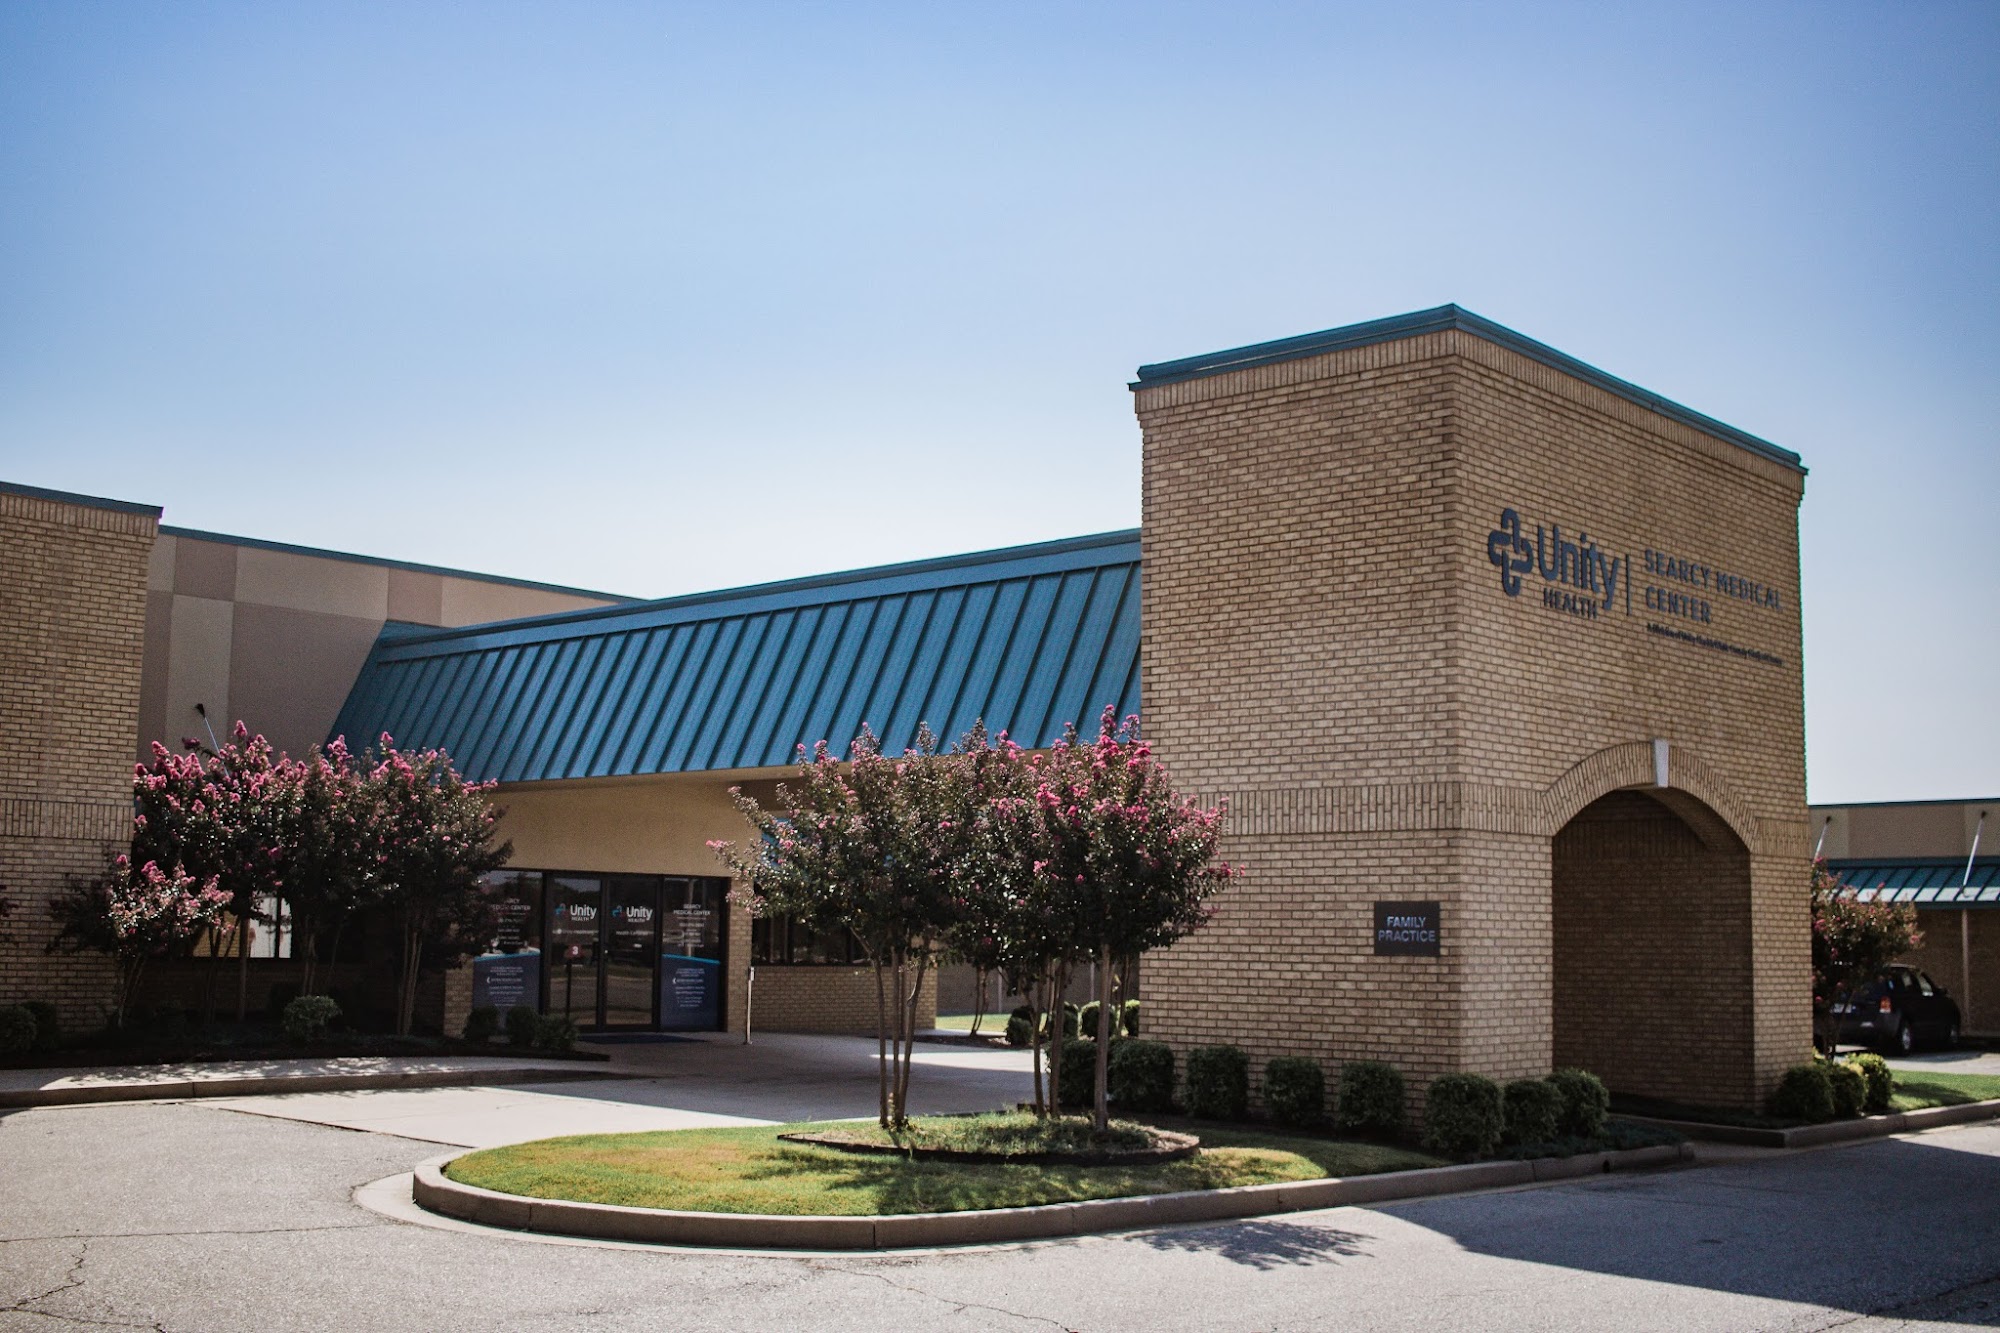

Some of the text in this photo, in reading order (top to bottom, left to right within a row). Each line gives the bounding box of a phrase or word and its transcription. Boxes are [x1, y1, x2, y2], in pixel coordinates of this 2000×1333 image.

[1537, 523, 1620, 611] Unity
[1644, 548, 1783, 612] SEARCY MEDICAL
[1543, 587, 1598, 619] HEALTH
[1646, 585, 1712, 625] CENTER
[570, 904, 597, 919] Unity
[626, 906, 653, 921] Unity
[1386, 916, 1426, 928] FAMILY
[1378, 929, 1436, 942] PRACTICE
